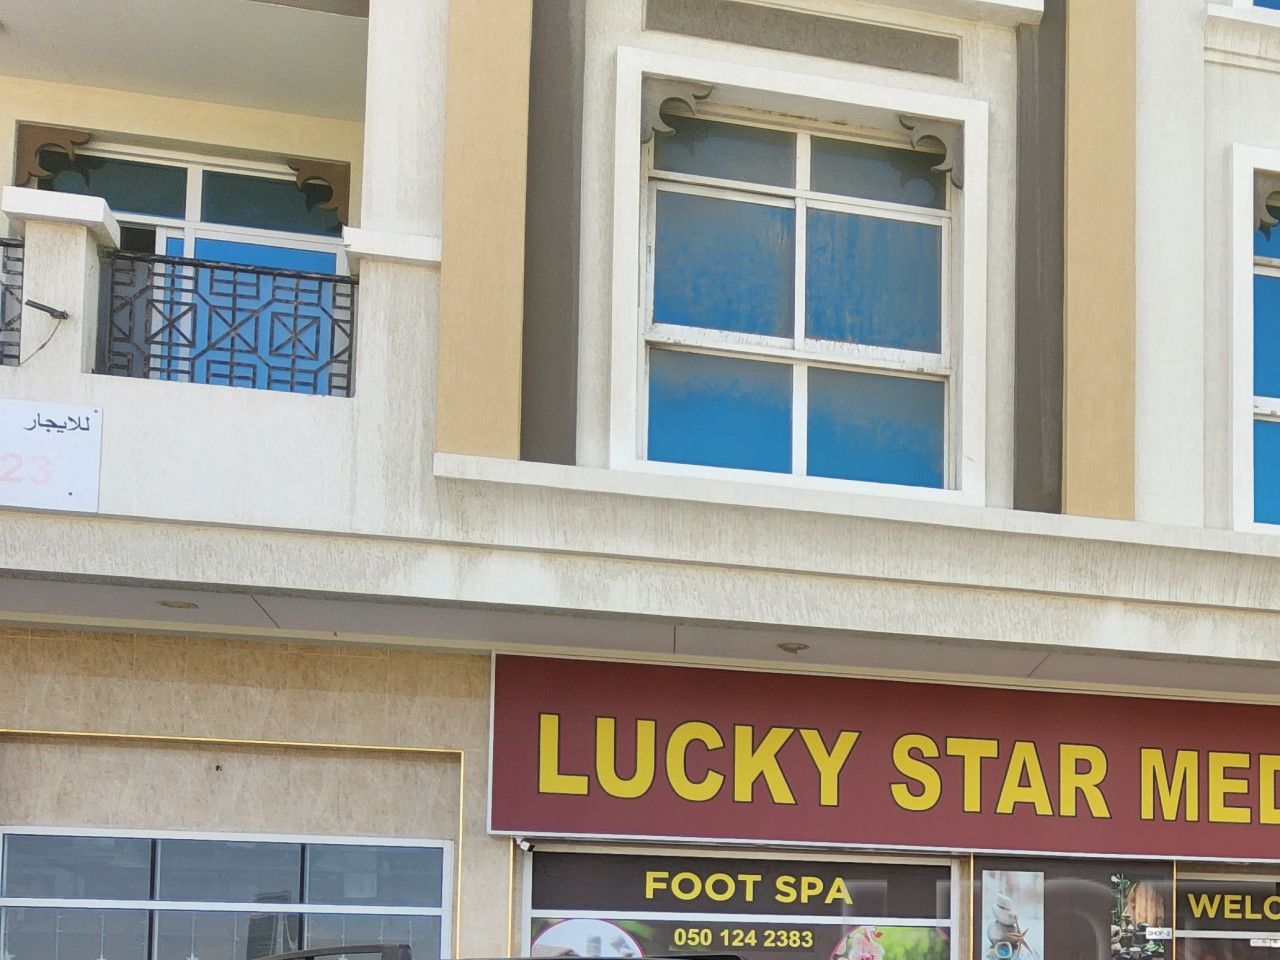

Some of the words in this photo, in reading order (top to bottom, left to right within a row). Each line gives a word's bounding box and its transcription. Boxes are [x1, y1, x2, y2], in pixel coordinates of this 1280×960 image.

[538, 713, 862, 807] LUCKY
[890, 734, 1111, 820] STAR
[645, 871, 762, 902] FOOT
[774, 875, 854, 905] SPA
[673, 928, 713, 946] 050
[720, 929, 757, 947] 124
[763, 930, 813, 948] 2383
